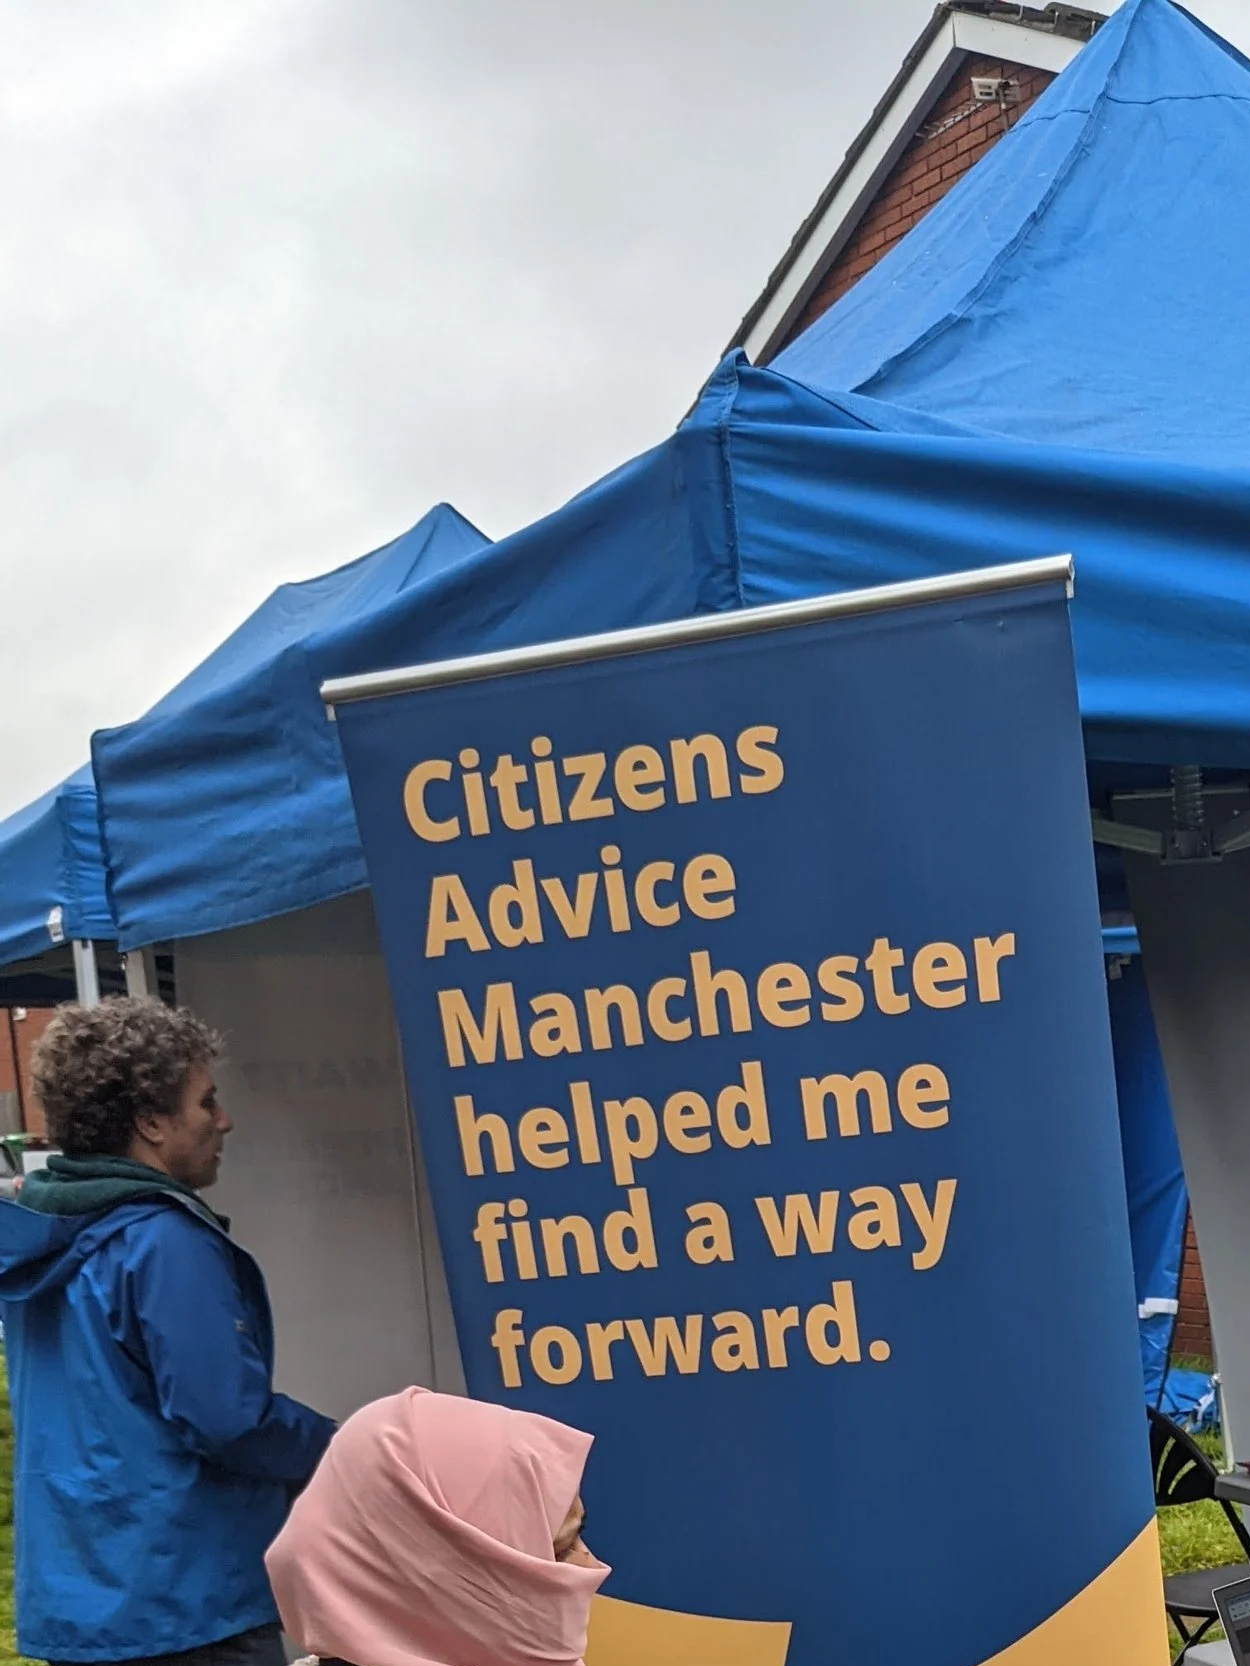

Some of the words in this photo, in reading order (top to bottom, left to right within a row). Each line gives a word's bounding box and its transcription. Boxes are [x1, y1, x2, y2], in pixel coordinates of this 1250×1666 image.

[404, 725, 784, 843] Citizens
[425, 845, 736, 958] Advice
[438, 932, 1015, 1068] Manchester
[454, 1061, 771, 1187] helped
[800, 1063, 949, 1141] me
[472, 1187, 657, 1284] find
[685, 1201, 733, 1265] a
[755, 1179, 957, 1271] way
[490, 1280, 890, 1389] forward.
